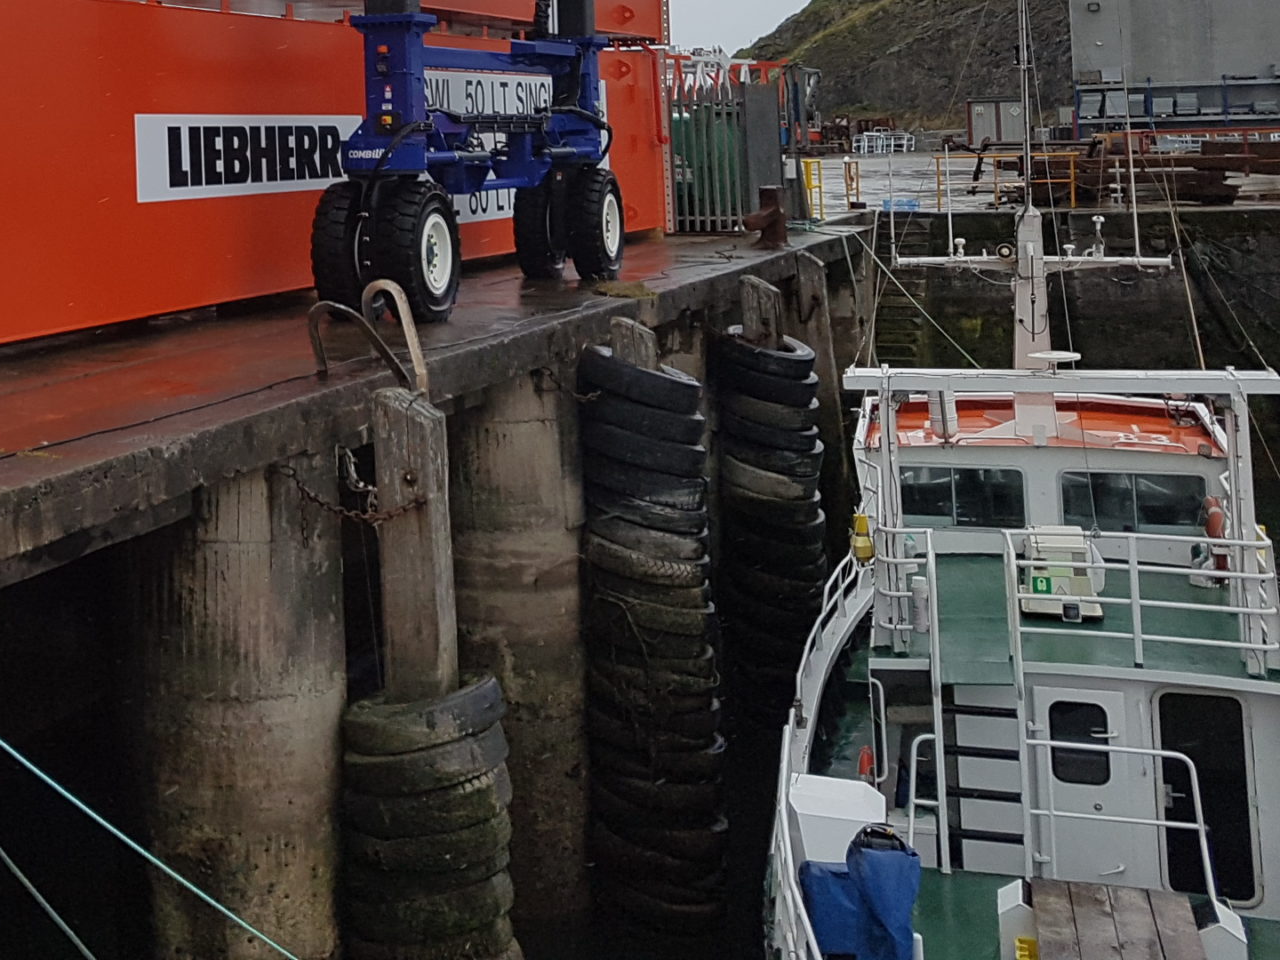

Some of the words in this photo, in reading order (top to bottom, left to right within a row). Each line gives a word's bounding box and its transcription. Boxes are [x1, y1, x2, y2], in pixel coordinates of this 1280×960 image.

[465, 79, 484, 115] 50
[491, 81, 509, 115] LT
[167, 125, 343, 188] LIEBHERR
